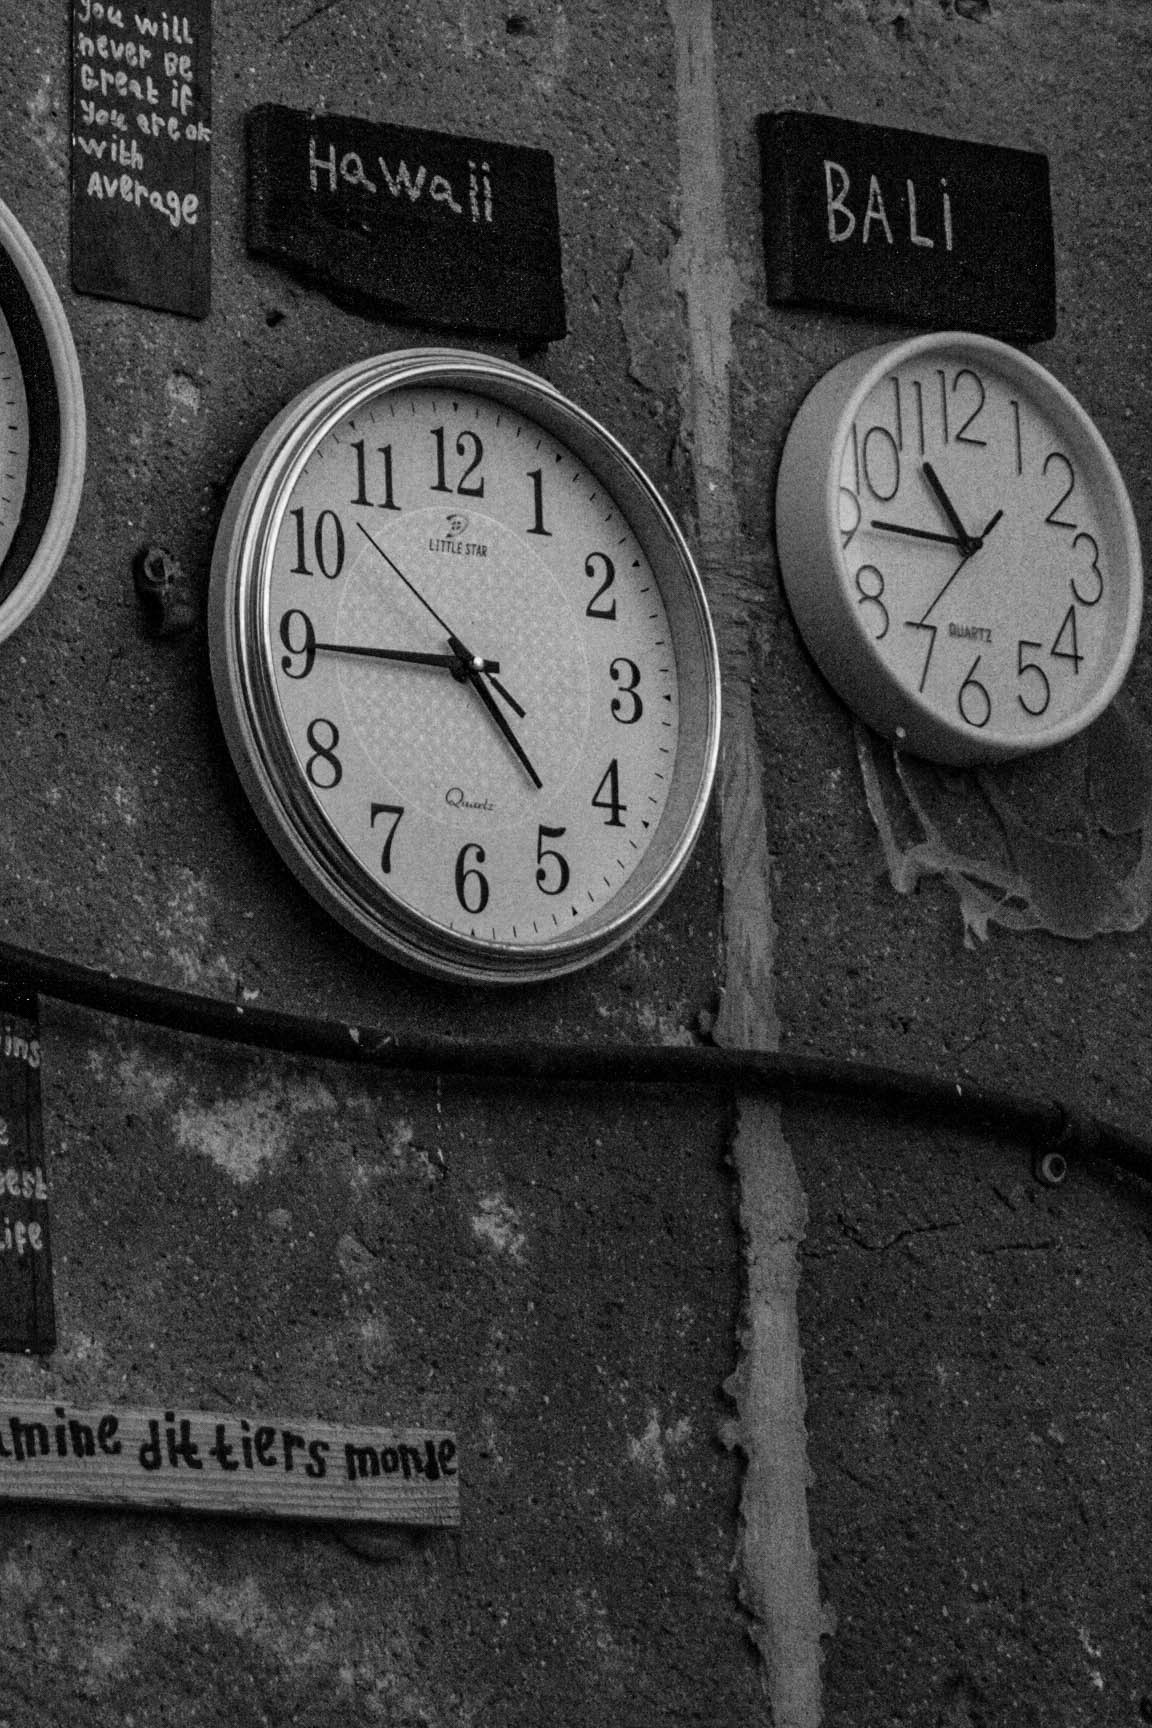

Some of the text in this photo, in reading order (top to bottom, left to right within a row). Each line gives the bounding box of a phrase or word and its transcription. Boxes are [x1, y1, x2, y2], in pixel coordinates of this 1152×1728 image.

[135, 111, 181, 141] are
[87, 170, 199, 228] Average
[891, 376, 925, 455] 11
[937, 369, 987, 446] 12
[1010, 400, 1022, 475] 1
[350, 438, 402, 511] 11
[429, 426, 485, 498] 12
[851, 421, 900, 501] 10
[1042, 452, 1077, 528] 2
[526, 468, 552, 537] 1
[289, 506, 346, 580] 10
[429, 538, 488, 558] LITTLE STAR
[1070, 532, 1104, 606] 3
[585, 551, 617, 621] 2
[279, 608, 317, 679] 9
[904, 620, 937, 694] 7
[948, 622, 993, 643] QUARTZ
[1050, 605, 1084, 674] 4
[608, 657, 643, 724] 3
[958, 655, 991, 728] 6
[1018, 639, 1050, 715] 5
[306, 717, 343, 789] 8
[444, 786, 497, 813] Quartz
[591, 758, 627, 828] 4
[369, 802, 405, 874] 7
[535, 824, 570, 896] 5
[454, 843, 490, 914] 6
[138, 1411, 203, 1471] dit
[210, 1419, 329, 1478] tiers
[344, 1439, 458, 1481] monde
